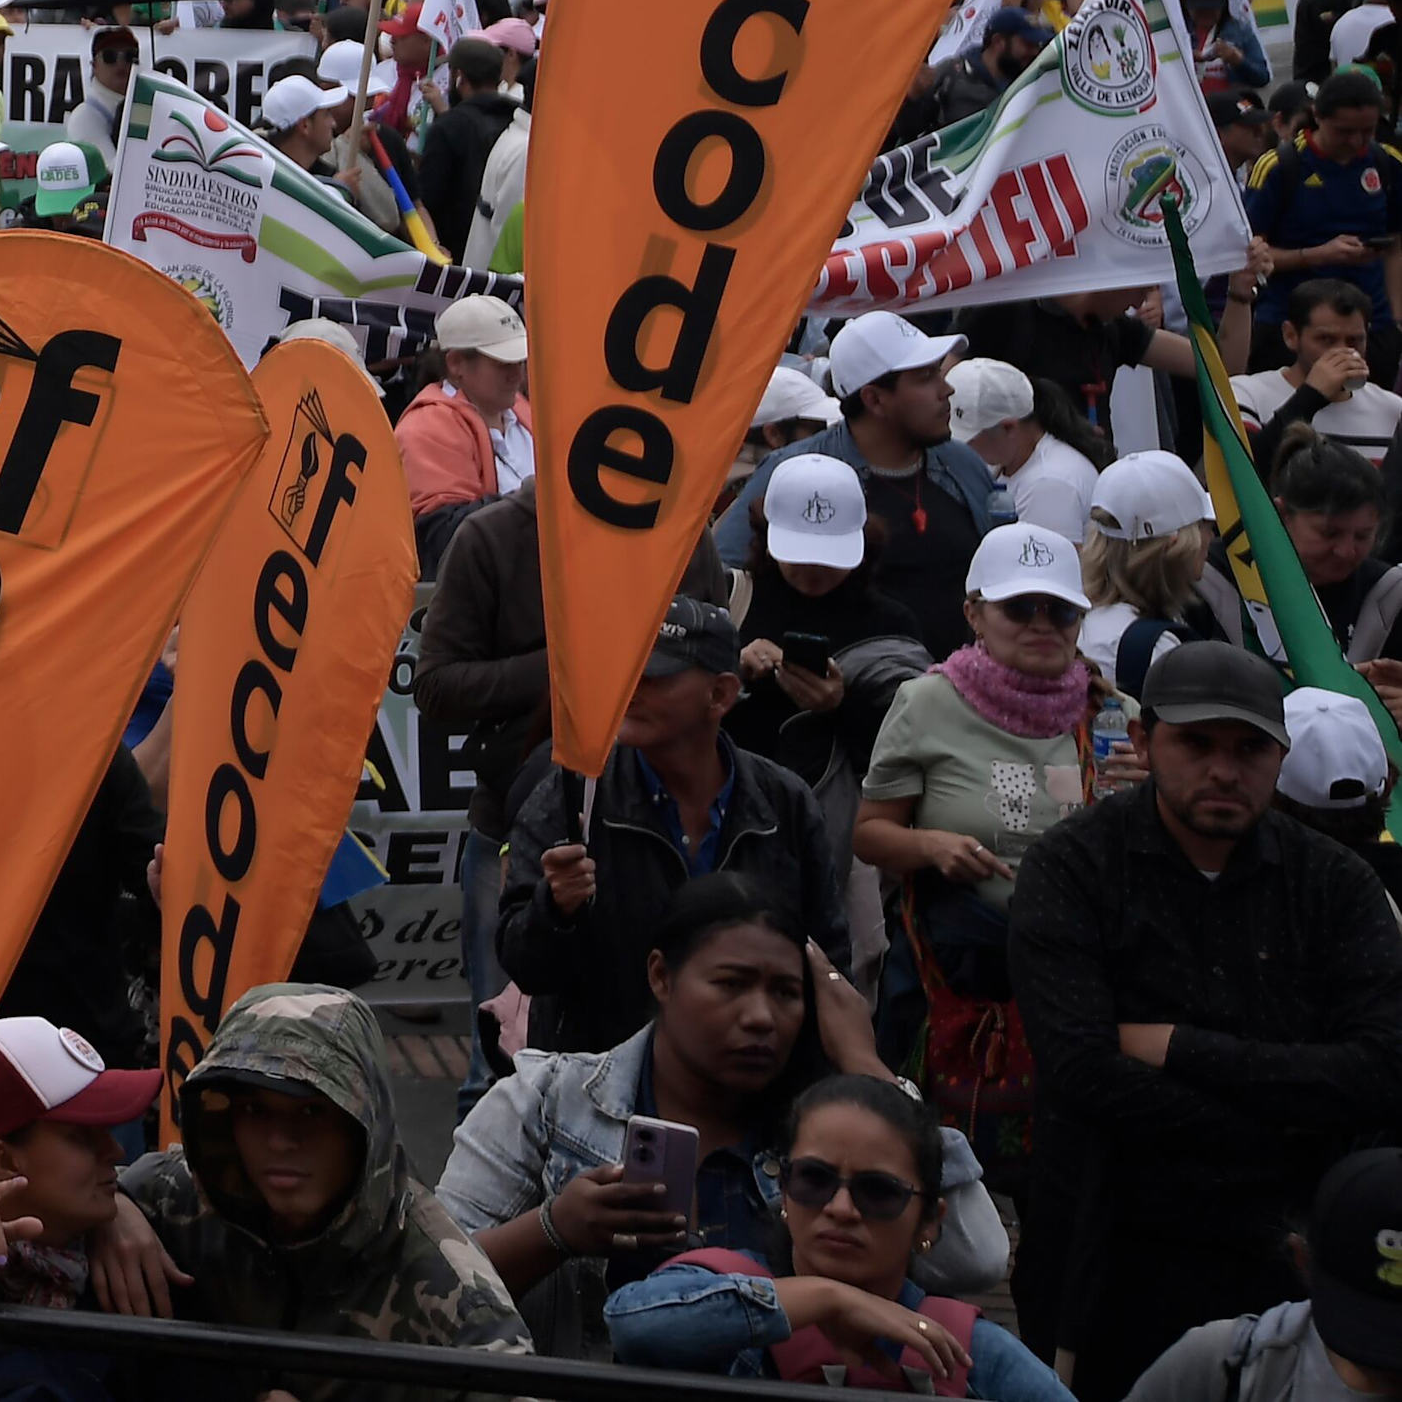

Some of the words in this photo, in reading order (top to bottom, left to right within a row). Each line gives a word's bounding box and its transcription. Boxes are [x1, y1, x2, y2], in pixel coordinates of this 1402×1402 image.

[1097, 90, 1112, 102] DE
[145, 165, 260, 211] SINDIMAESTROS
[144, 201, 199, 216] EDUCACIÓN
[201, 210, 214, 219] DE
[145, 183, 191, 198] SINDICATO
[194, 191, 207, 201] DE
[209, 195, 256, 219] MAESTROS
[154, 194, 227, 217] TRABAJADORES
